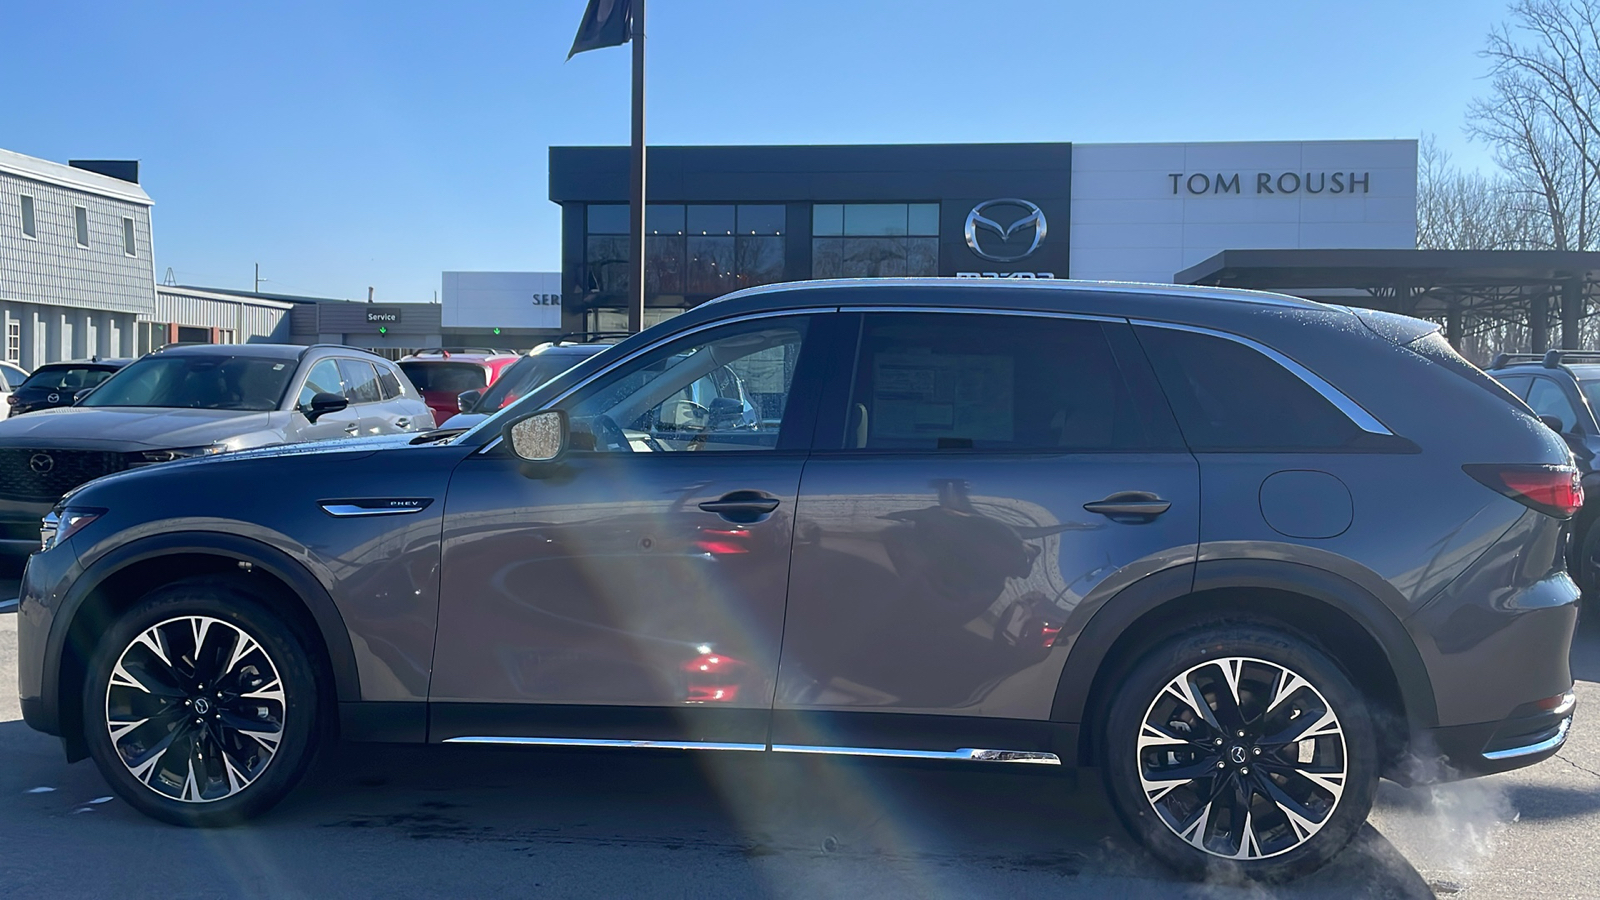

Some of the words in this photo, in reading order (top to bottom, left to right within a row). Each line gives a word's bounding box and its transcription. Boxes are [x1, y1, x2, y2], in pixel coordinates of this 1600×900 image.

[1168, 173, 1241, 194] TOM
[1256, 172, 1370, 194] ROUSH
[532, 293, 562, 306] SER
[368, 313, 396, 321] Service
